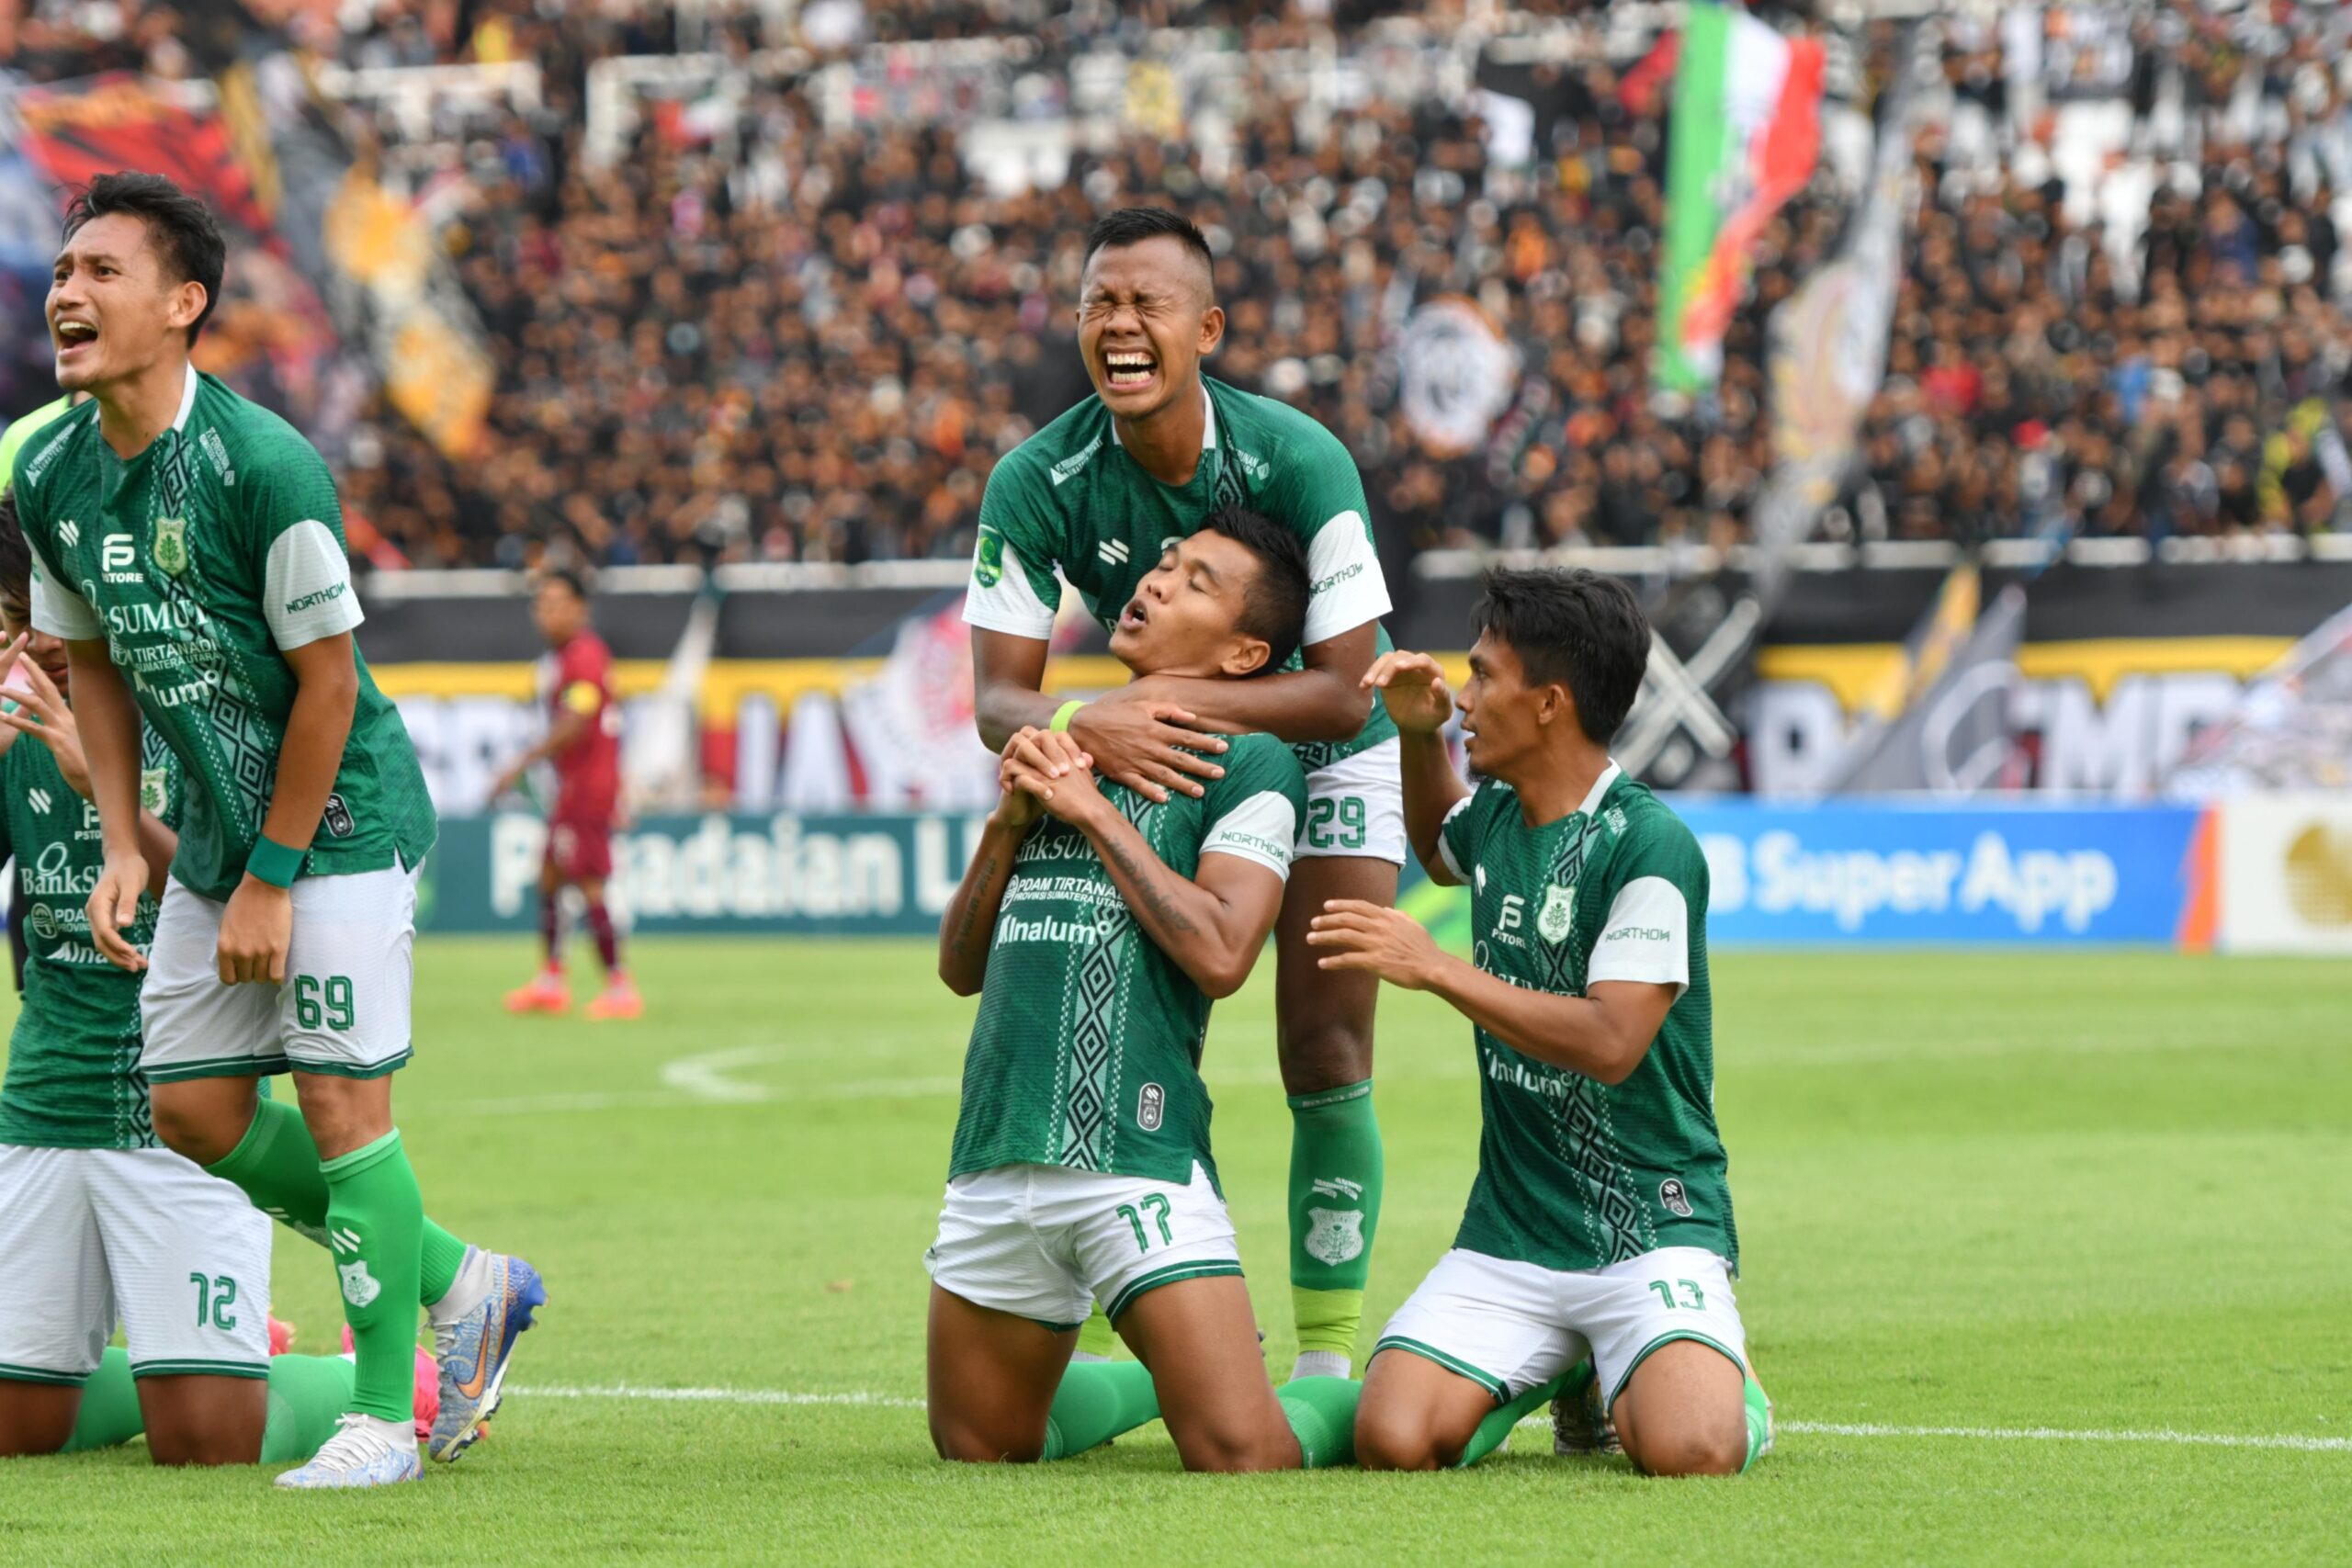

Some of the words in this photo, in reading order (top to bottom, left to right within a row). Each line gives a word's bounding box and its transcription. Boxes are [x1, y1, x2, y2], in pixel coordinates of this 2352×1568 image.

[102, 572, 143, 583] TORE
[74, 830, 104, 840] PSTO
[1308, 796, 1366, 849] 29
[20, 865, 104, 895] BankS
[490, 812, 904, 928] Padaian
[1751, 829, 1962, 933] Super
[1959, 830, 2119, 934] App
[1014, 891, 1046, 902] PROVINSI
[1046, 891, 1094, 904] SUMATERA
[1018, 877, 1053, 892] PDAM
[1055, 877, 1125, 900] TIRTANA
[54, 908, 87, 922] PDA
[57, 922, 91, 933] PROVIN
[294, 975, 355, 1031] 69
[1115, 1192, 1172, 1254] 17
[190, 1272, 236, 1330] 12
[1648, 1278, 1707, 1311] 13
